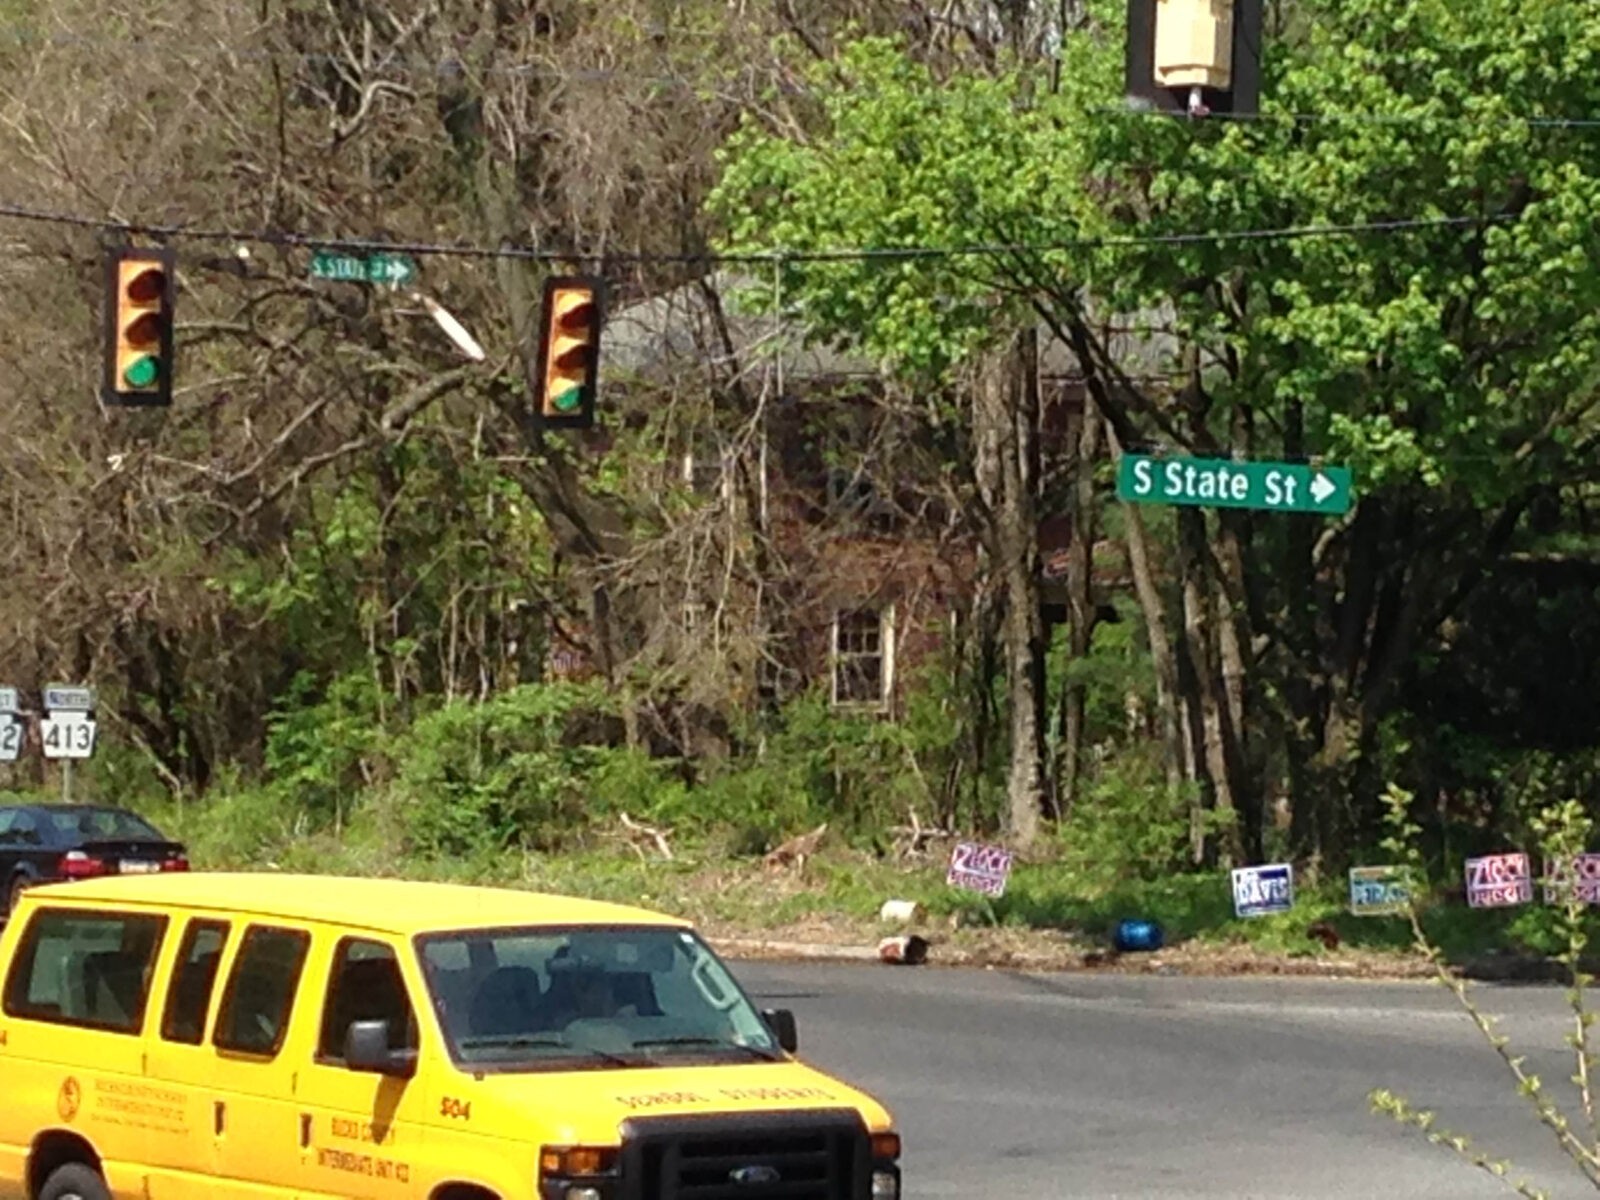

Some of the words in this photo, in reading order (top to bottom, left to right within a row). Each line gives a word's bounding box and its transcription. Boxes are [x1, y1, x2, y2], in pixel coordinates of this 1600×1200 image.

[1133, 460, 1152, 495] S
[1164, 461, 1249, 501] State
[1265, 471, 1298, 506] St
[44, 723, 92, 750] 413
